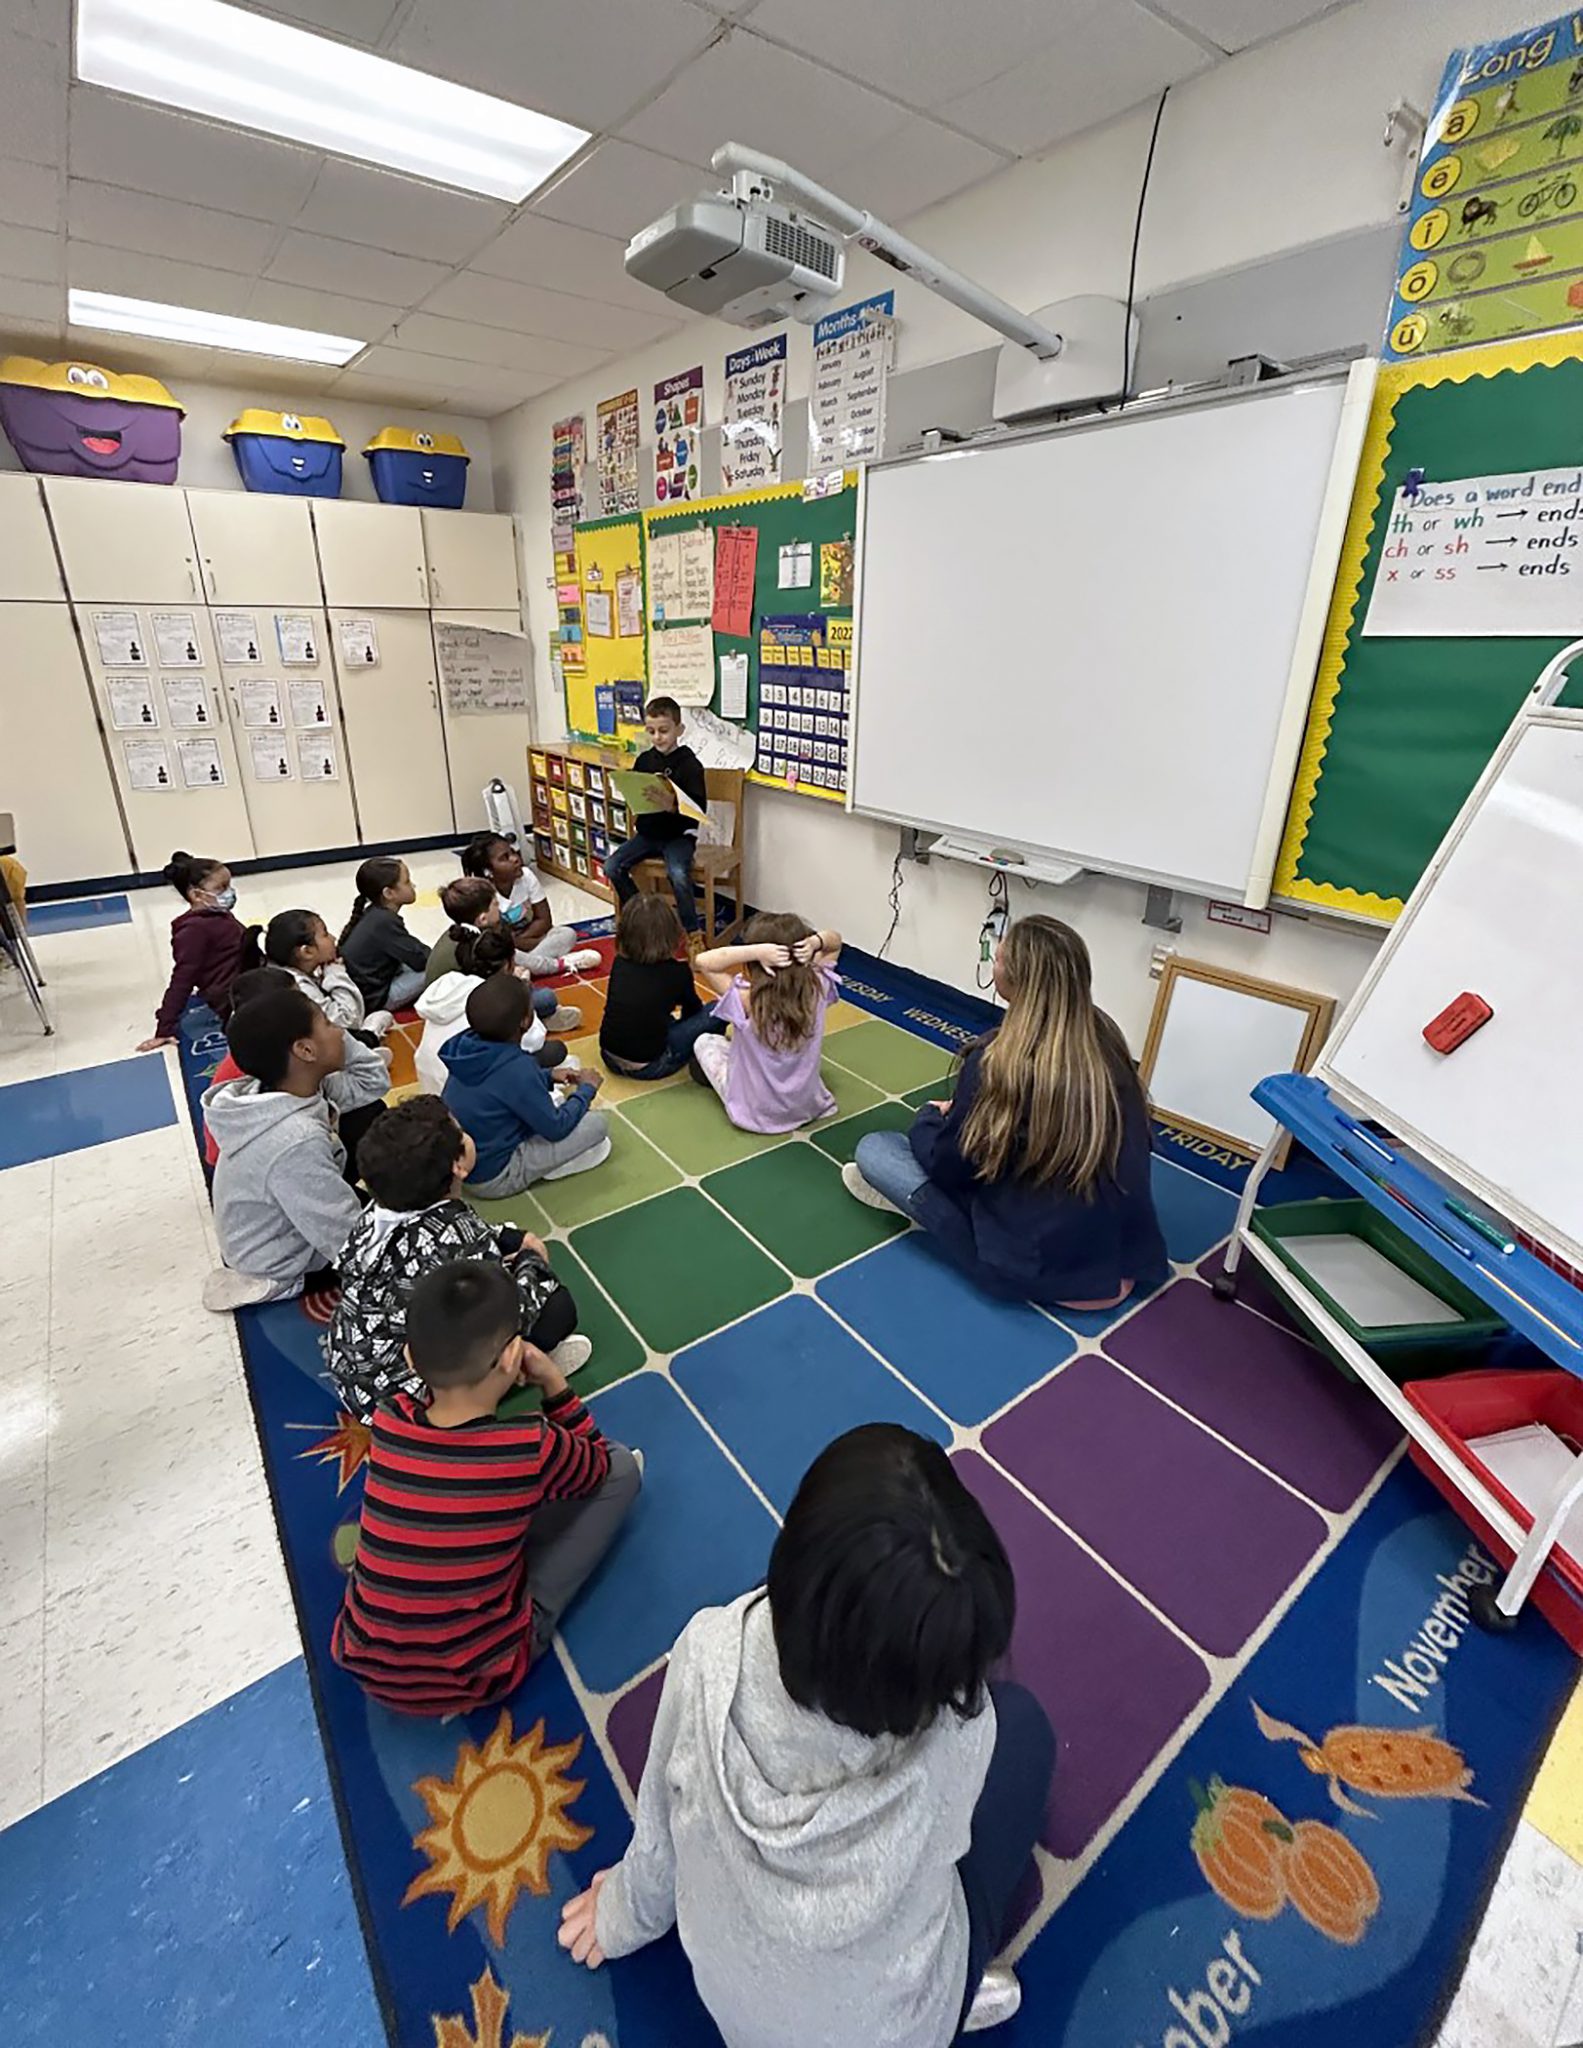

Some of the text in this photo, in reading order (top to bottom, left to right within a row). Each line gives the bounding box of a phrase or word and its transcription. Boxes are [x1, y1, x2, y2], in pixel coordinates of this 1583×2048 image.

[1462, 31, 1557, 85] Long
[817, 312, 857, 340] Months
[728, 355, 751, 372] Days
[754, 341, 781, 367] Week
[738, 372, 766, 389] Sunday
[736, 388, 767, 405] Monday
[736, 404, 765, 420] Tuesday
[734, 435, 766, 450] Thursday
[739, 451, 761, 464] Friday
[733, 465, 765, 481] Saturday
[1409, 488, 1455, 508] Does
[1464, 492, 1478, 503] a
[1486, 476, 1536, 501] word
[1391, 513, 1413, 534] th
[1422, 518, 1441, 532] or
[1453, 507, 1485, 530] wh
[1384, 526, 1579, 559] ch or sh ends
[1386, 553, 1572, 582] x or ss ends
[830, 721, 838, 734] 14
[841, 975, 979, 1044] UESDAY WEDNESD
[1157, 1127, 1252, 1171] FRIDAY
[1371, 1542, 1499, 1714] November
